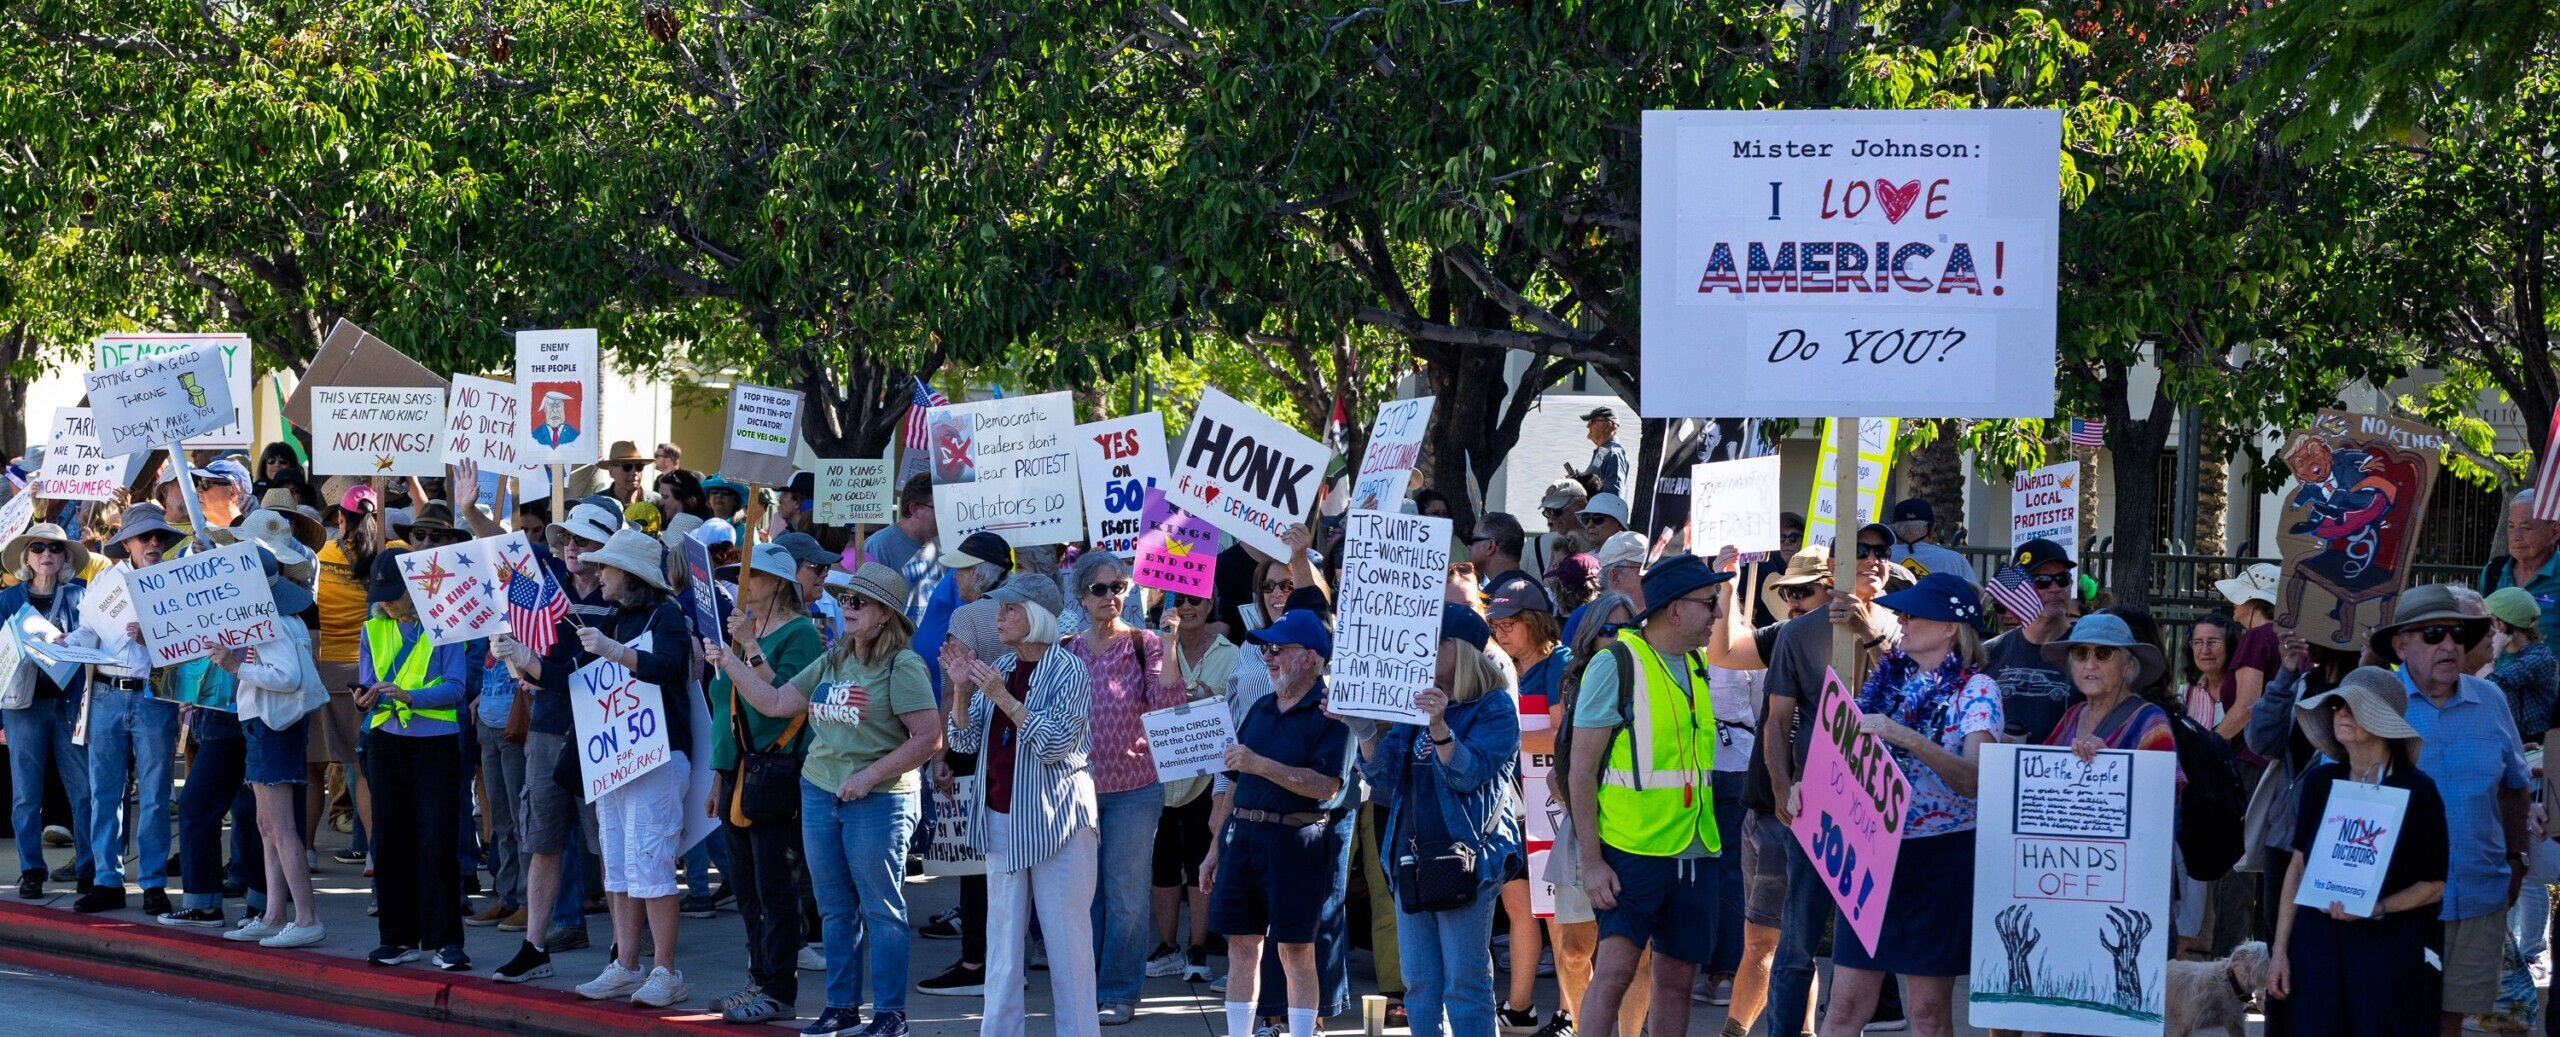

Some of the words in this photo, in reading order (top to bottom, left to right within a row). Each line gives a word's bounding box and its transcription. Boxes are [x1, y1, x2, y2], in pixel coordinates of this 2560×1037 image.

[1732, 140, 1834, 158] Mister
[1851, 139, 1982, 158] Johnson:
[1768, 181, 1783, 221] I
[1697, 240, 2005, 297] AMERICA!
[540, 342, 570, 352] ENEMY
[1768, 328, 1820, 364] Do
[1842, 327, 1966, 365] YOU?
[91, 370, 132, 392] SITTING
[134, 365, 154, 379] ON
[157, 363, 169, 373] A
[168, 351, 200, 370] GOLD
[531, 365, 546, 373] THE
[547, 364, 577, 373] PEOPLE
[116, 386, 168, 409] THRONE
[319, 391, 345, 404] THIS
[347, 392, 401, 404] VETERAN
[403, 393, 437, 406] SAYS:
[456, 386, 481, 408] NO
[486, 391, 517, 416] TYR
[743, 391, 762, 402] STOP
[762, 395, 776, 405] THE
[775, 397, 791, 407] GOP
[331, 408, 348, 420] HE
[379, 409, 396, 420] NO
[396, 409, 428, 421] KING!
[738, 403, 755, 413] AND
[755, 406, 766, 415] ITS
[766, 408, 793, 420] TIN-POT
[975, 406, 1047, 432] Democratic
[1375, 400, 1419, 439] STOP
[2483, 408, 2518, 422] CITY
[112, 416, 160, 444] DOESN'T
[165, 412, 191, 428] MAKE
[193, 406, 216, 422] YOU
[450, 410, 473, 431] NO
[478, 415, 516, 439] DICTA
[747, 417, 783, 430] DICTATOR!
[2360, 415, 2388, 436] NO
[2388, 425, 2444, 450] KINGS
[145, 434, 156, 448] A
[161, 424, 196, 444] KING
[332, 431, 366, 452] NO!
[368, 432, 434, 453] KINGS!
[736, 428, 756, 439] VOTE
[756, 431, 768, 441] YES
[768, 434, 779, 444] ON
[778, 436, 787, 444] 50
[977, 435, 1024, 457] Leaders
[1092, 428, 1140, 461] YES
[53, 445, 69, 456] ARE
[75, 444, 107, 460] TAX
[449, 432, 470, 453] NO
[483, 438, 516, 464] KIN
[56, 464, 80, 476] PAID
[85, 464, 100, 477] BY
[826, 465, 844, 476] NO
[849, 464, 884, 475] KINGS
[977, 465, 1007, 483] fear
[1015, 452, 1070, 479] PROTEST
[1112, 463, 1132, 478] ON
[1186, 415, 1314, 516] HONK
[44, 479, 112, 497] CONSUMERS
[828, 478, 843, 488] NO
[847, 476, 887, 489] CROWNS
[1178, 474, 1192, 495] if
[1193, 484, 1202, 498] u
[1658, 477, 1676, 494] THE
[2015, 473, 2054, 492] UNPAID
[829, 493, 843, 502] NO
[844, 491, 878, 502] GOLDEN
[2025, 490, 2063, 508] LOCAL
[846, 503, 882, 513] TOILETS
[956, 494, 1036, 523] Dictators
[1045, 493, 1065, 512] DO
[2014, 506, 2074, 530] PROTESTER
[1100, 518, 1140, 539] PROTE
[1149, 520, 1211, 541] KINGS
[1352, 514, 1431, 544] TRUMP'S
[2026, 528, 2059, 541] DISDAIN
[1096, 536, 1139, 552] DEMOC
[138, 573, 166, 594] NO
[168, 556, 235, 585] TROOPS
[240, 553, 257, 572] IN
[1145, 552, 1178, 567] END
[1183, 561, 1207, 573] OF
[1141, 567, 1202, 587] STORY
[98, 593, 114, 612] SMASH
[112, 585, 124, 601] THE
[109, 598, 128, 619] CROWN
[152, 599, 183, 616] U.S.
[186, 582, 241, 608] CITIES
[428, 603, 445, 620] NO
[444, 575, 478, 606] KINGS
[444, 614, 460, 629] IN
[457, 596, 480, 618] THE
[468, 606, 495, 630] USA!
[152, 621, 182, 641] LA
[217, 619, 276, 647] NEXT?
[1335, 657, 1345, 675] I
[1349, 657, 1370, 679] AM
[597, 679, 641, 724] YES
[825, 686, 850, 706] NO
[813, 703, 860, 728] KINGS
[587, 726, 618, 764] ON
[627, 707, 656, 745] 50
[1149, 728, 1170, 739] Stop
[1170, 724, 1185, 736] the
[1186, 717, 1222, 732] CIRCUS
[1152, 738, 1170, 748] Get
[1169, 735, 1184, 746] the
[1184, 727, 1226, 743] CLOWNS
[616, 748, 635, 765] FOR
[1174, 746, 1189, 756] out
[1189, 743, 1200, 752] of
[1199, 741, 1215, 751] the
[1821, 680, 1904, 834] CONGRESS
[592, 744, 665, 796] DEMOCRACY
[1159, 750, 1224, 770] Administration!
[2022, 754, 2052, 779] We
[2053, 758, 2072, 781] the
[2068, 759, 2119, 788] People
[1830, 759, 1845, 796] DO
[1849, 791, 1877, 855] YOUR
[2337, 818, 2360, 843] NO
[1812, 809, 1875, 921] JOB!
[2022, 843, 2118, 872] HANDS
[2331, 843, 2378, 866] DICTATORS
[2038, 872, 2103, 897] OFF
[2313, 878, 2326, 889] Yes
[2325, 881, 2367, 898] Democracy
